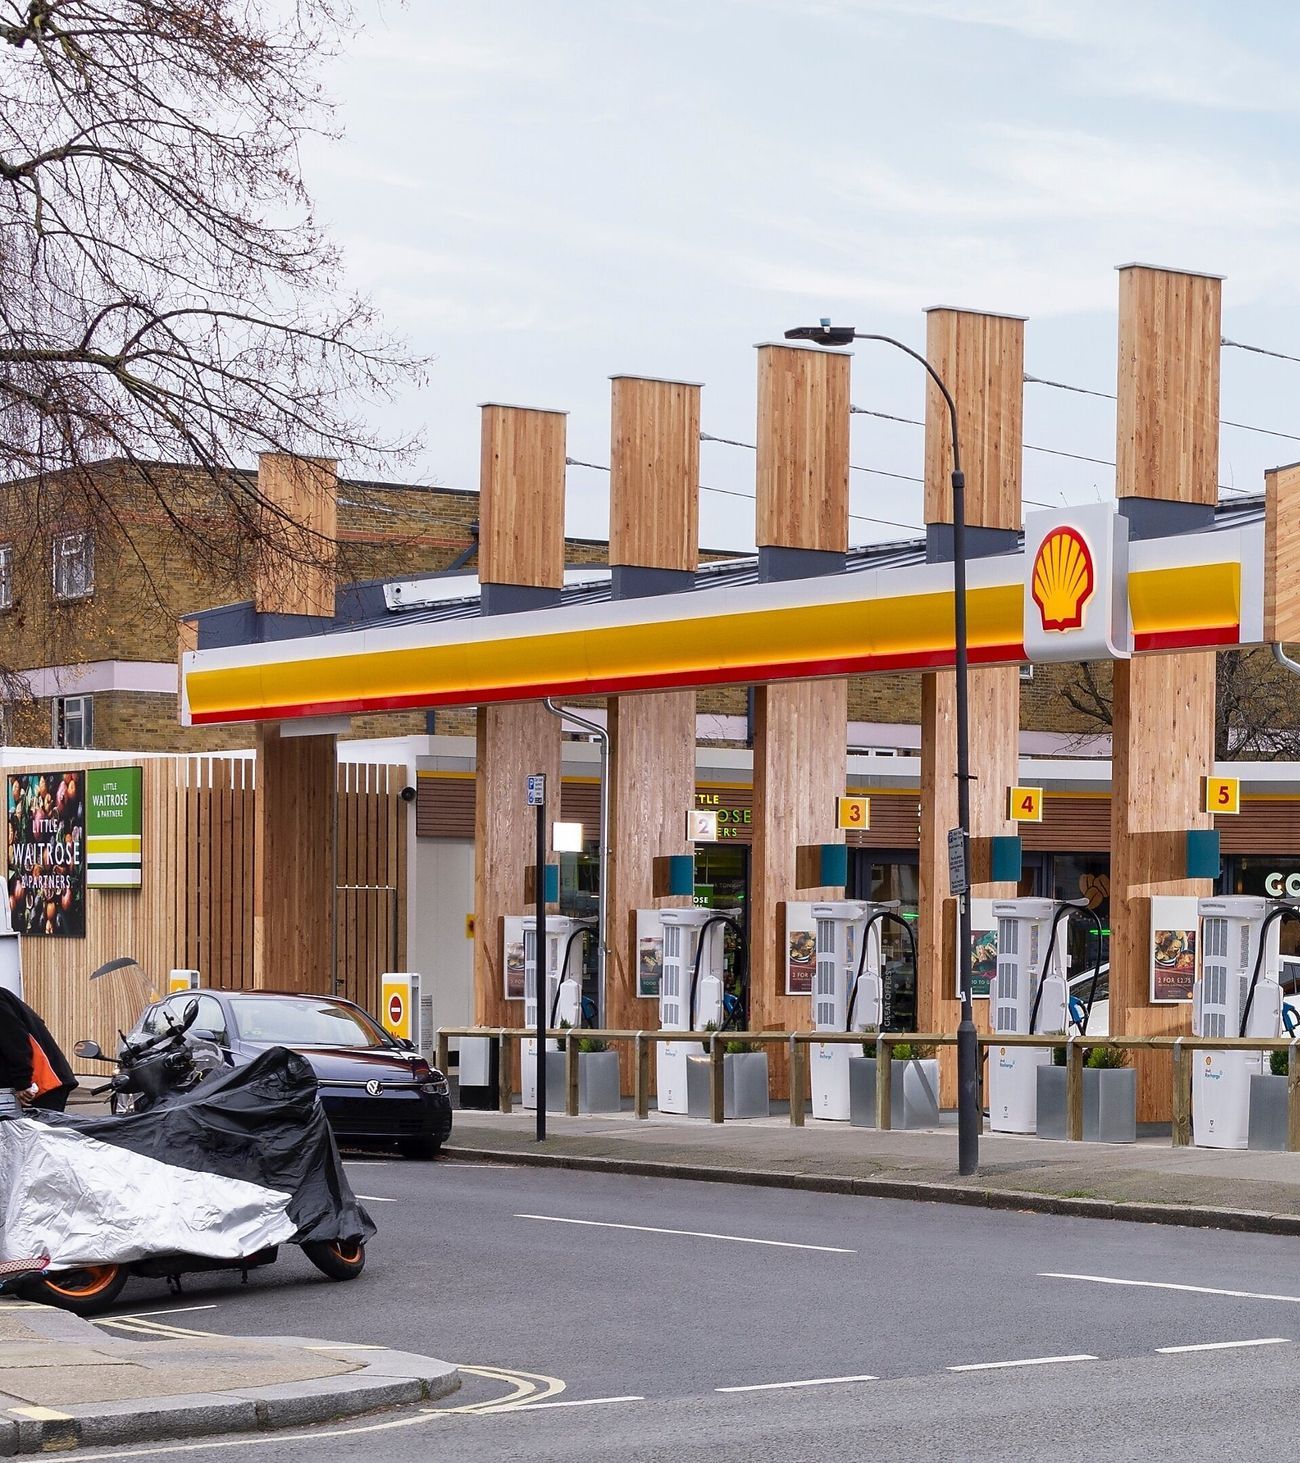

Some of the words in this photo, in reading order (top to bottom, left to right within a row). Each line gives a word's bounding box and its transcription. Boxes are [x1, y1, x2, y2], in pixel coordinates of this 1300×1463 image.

[103, 783, 117, 791] LITTLE
[92, 794, 128, 806] WAITROSE
[1218, 786, 1230, 804] 5
[1021, 796, 1034, 812] 4
[101, 810, 123, 818] PARTNERS
[850, 804, 860, 821] 3
[32, 819, 58, 833] LITTLE
[698, 819, 709, 834] 2
[13, 842, 80, 865] WAITROSE
[28, 875, 71, 888] PARTNERS
